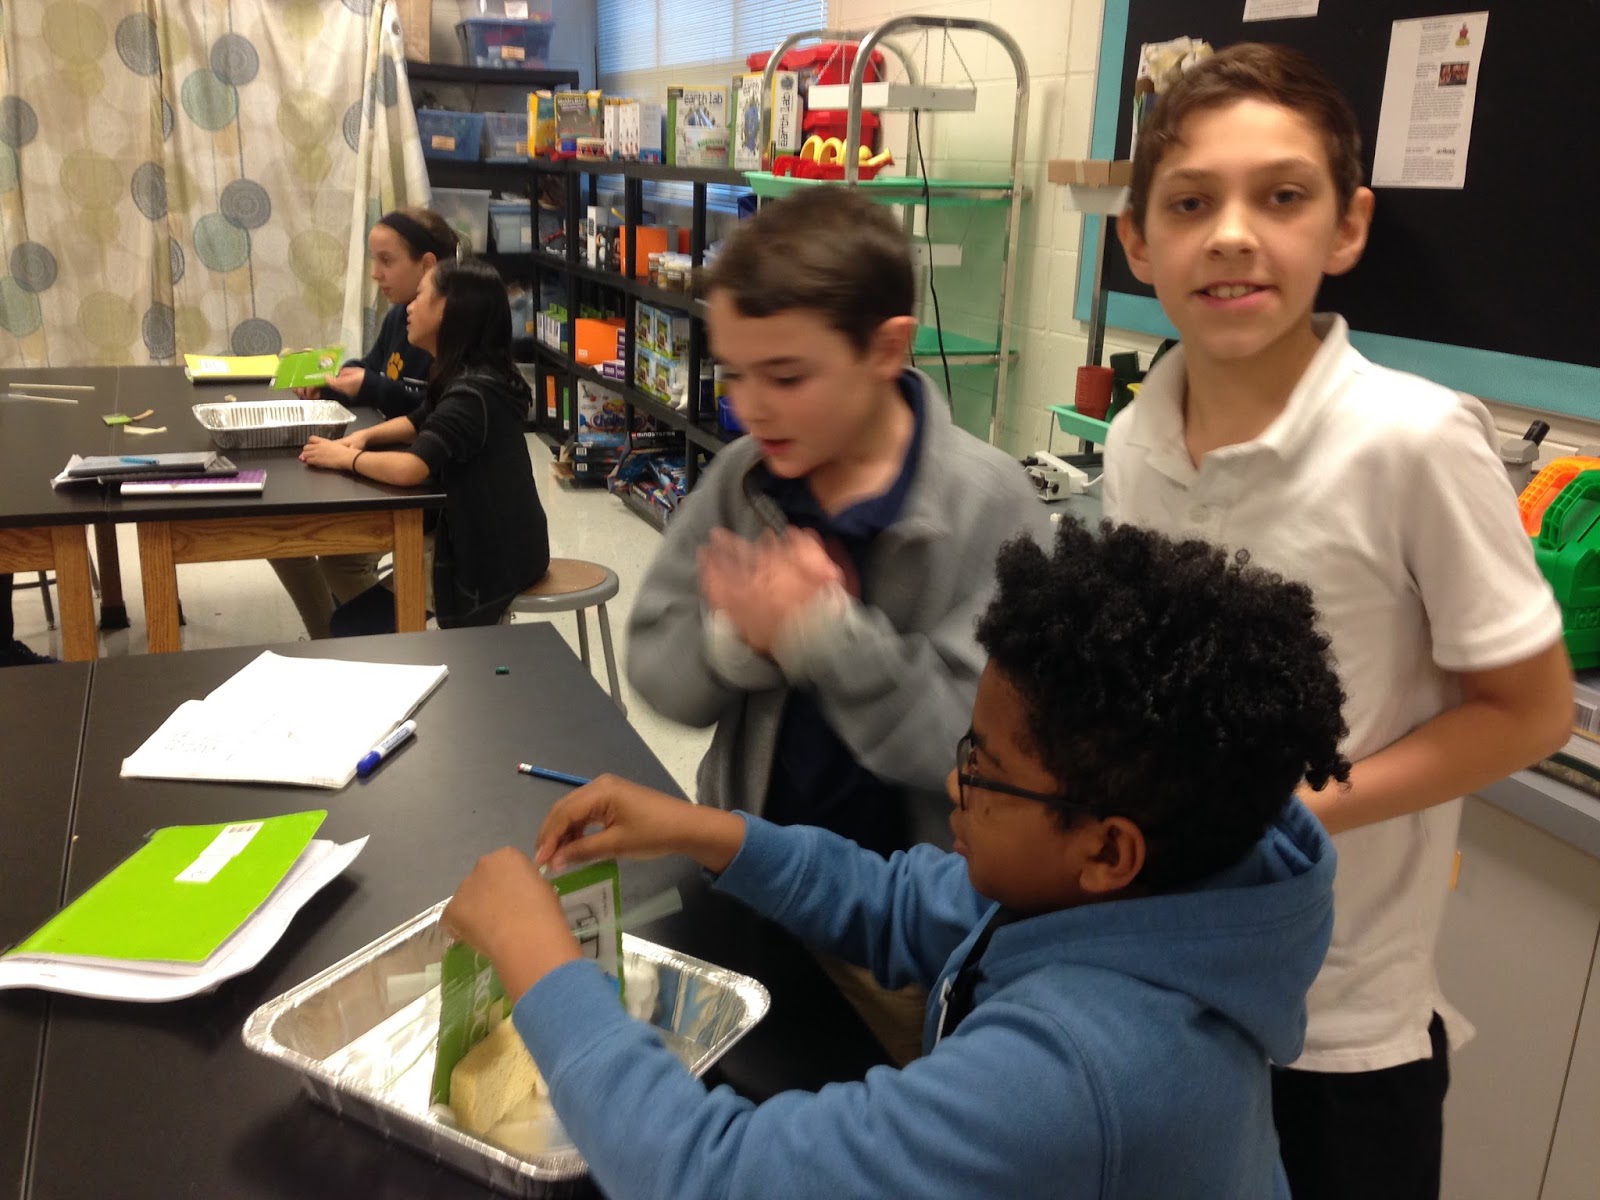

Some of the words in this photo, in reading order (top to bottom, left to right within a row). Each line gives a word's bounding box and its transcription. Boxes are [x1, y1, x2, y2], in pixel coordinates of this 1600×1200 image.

[743, 80, 760, 95] earth
[684, 92, 707, 106] earth
[709, 91, 722, 105] lab
[780, 94, 791, 113] lab
[780, 114, 789, 147] earth
